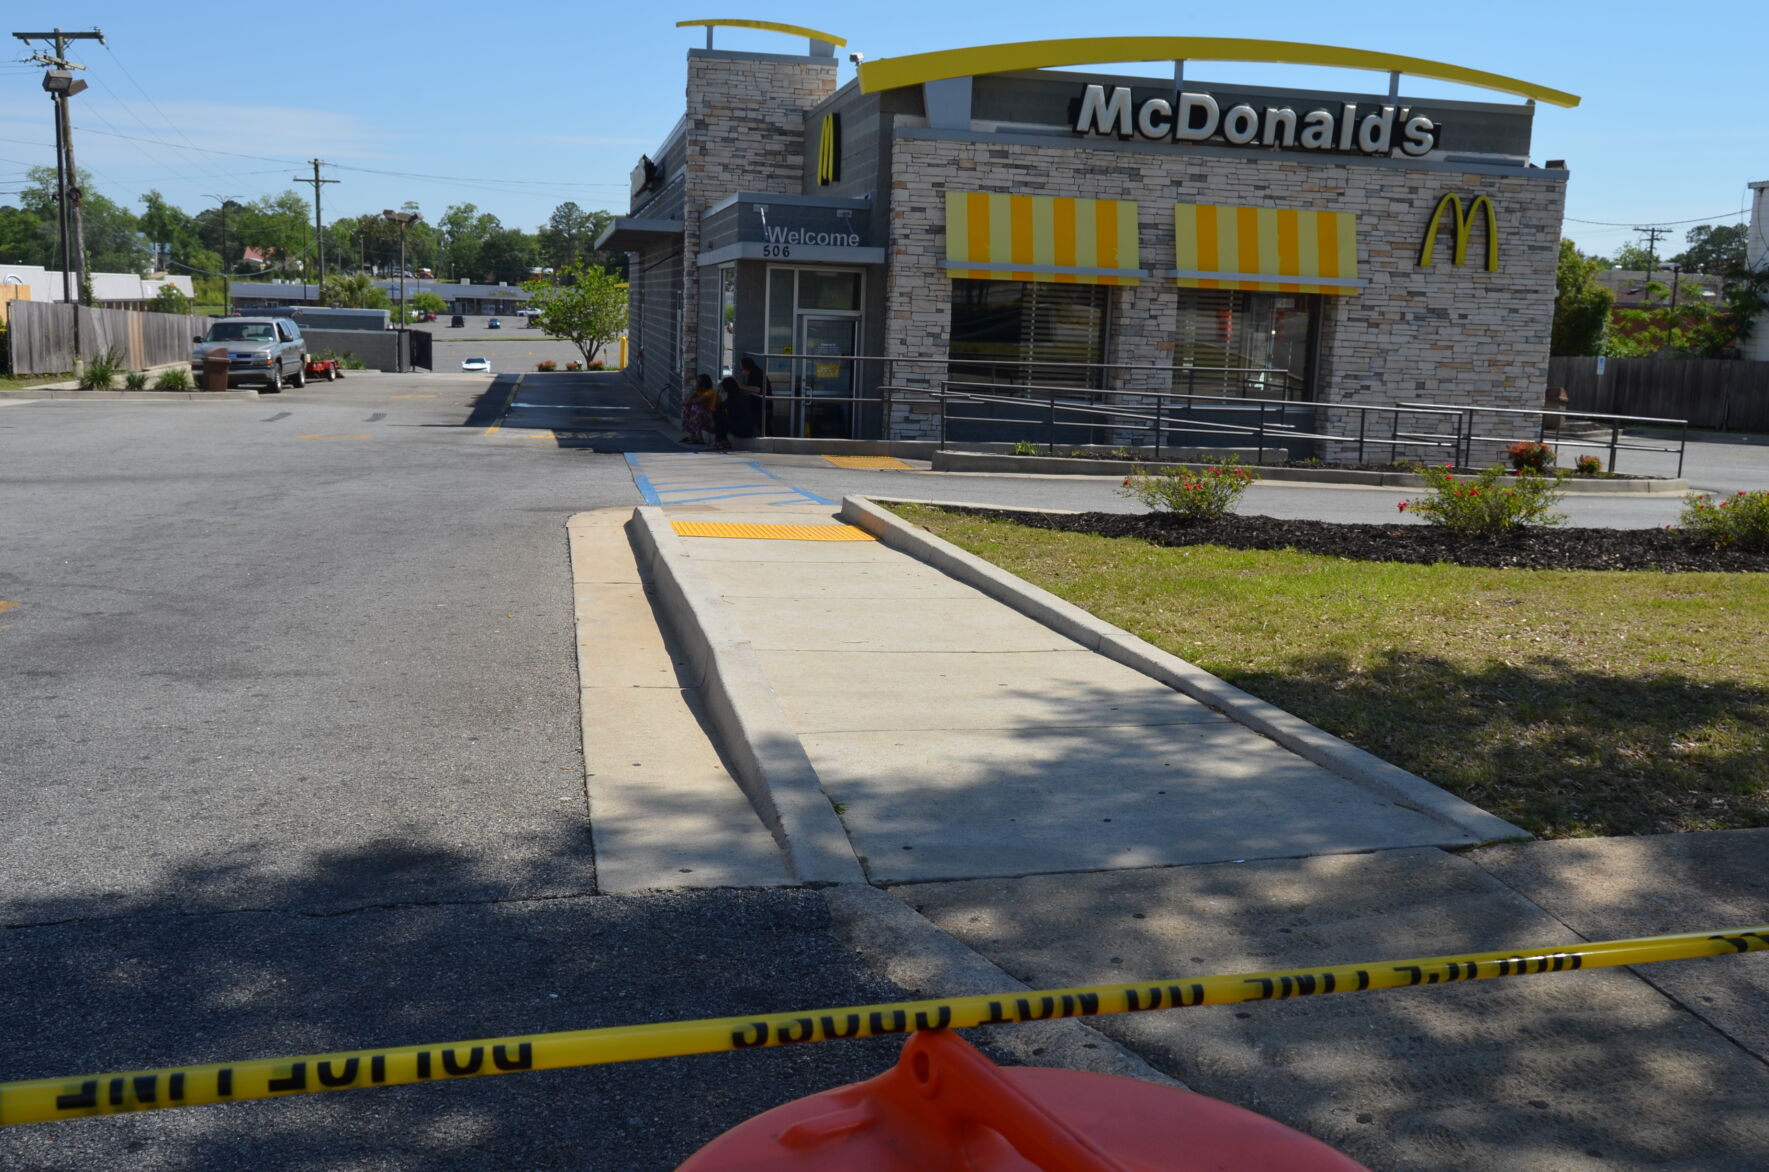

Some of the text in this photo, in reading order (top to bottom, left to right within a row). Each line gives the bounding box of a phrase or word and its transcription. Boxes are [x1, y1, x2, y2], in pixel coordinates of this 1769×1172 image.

[1074, 83, 1437, 156] McDonald's
[767, 226, 860, 247] Welcome
[763, 244, 790, 258] 506
